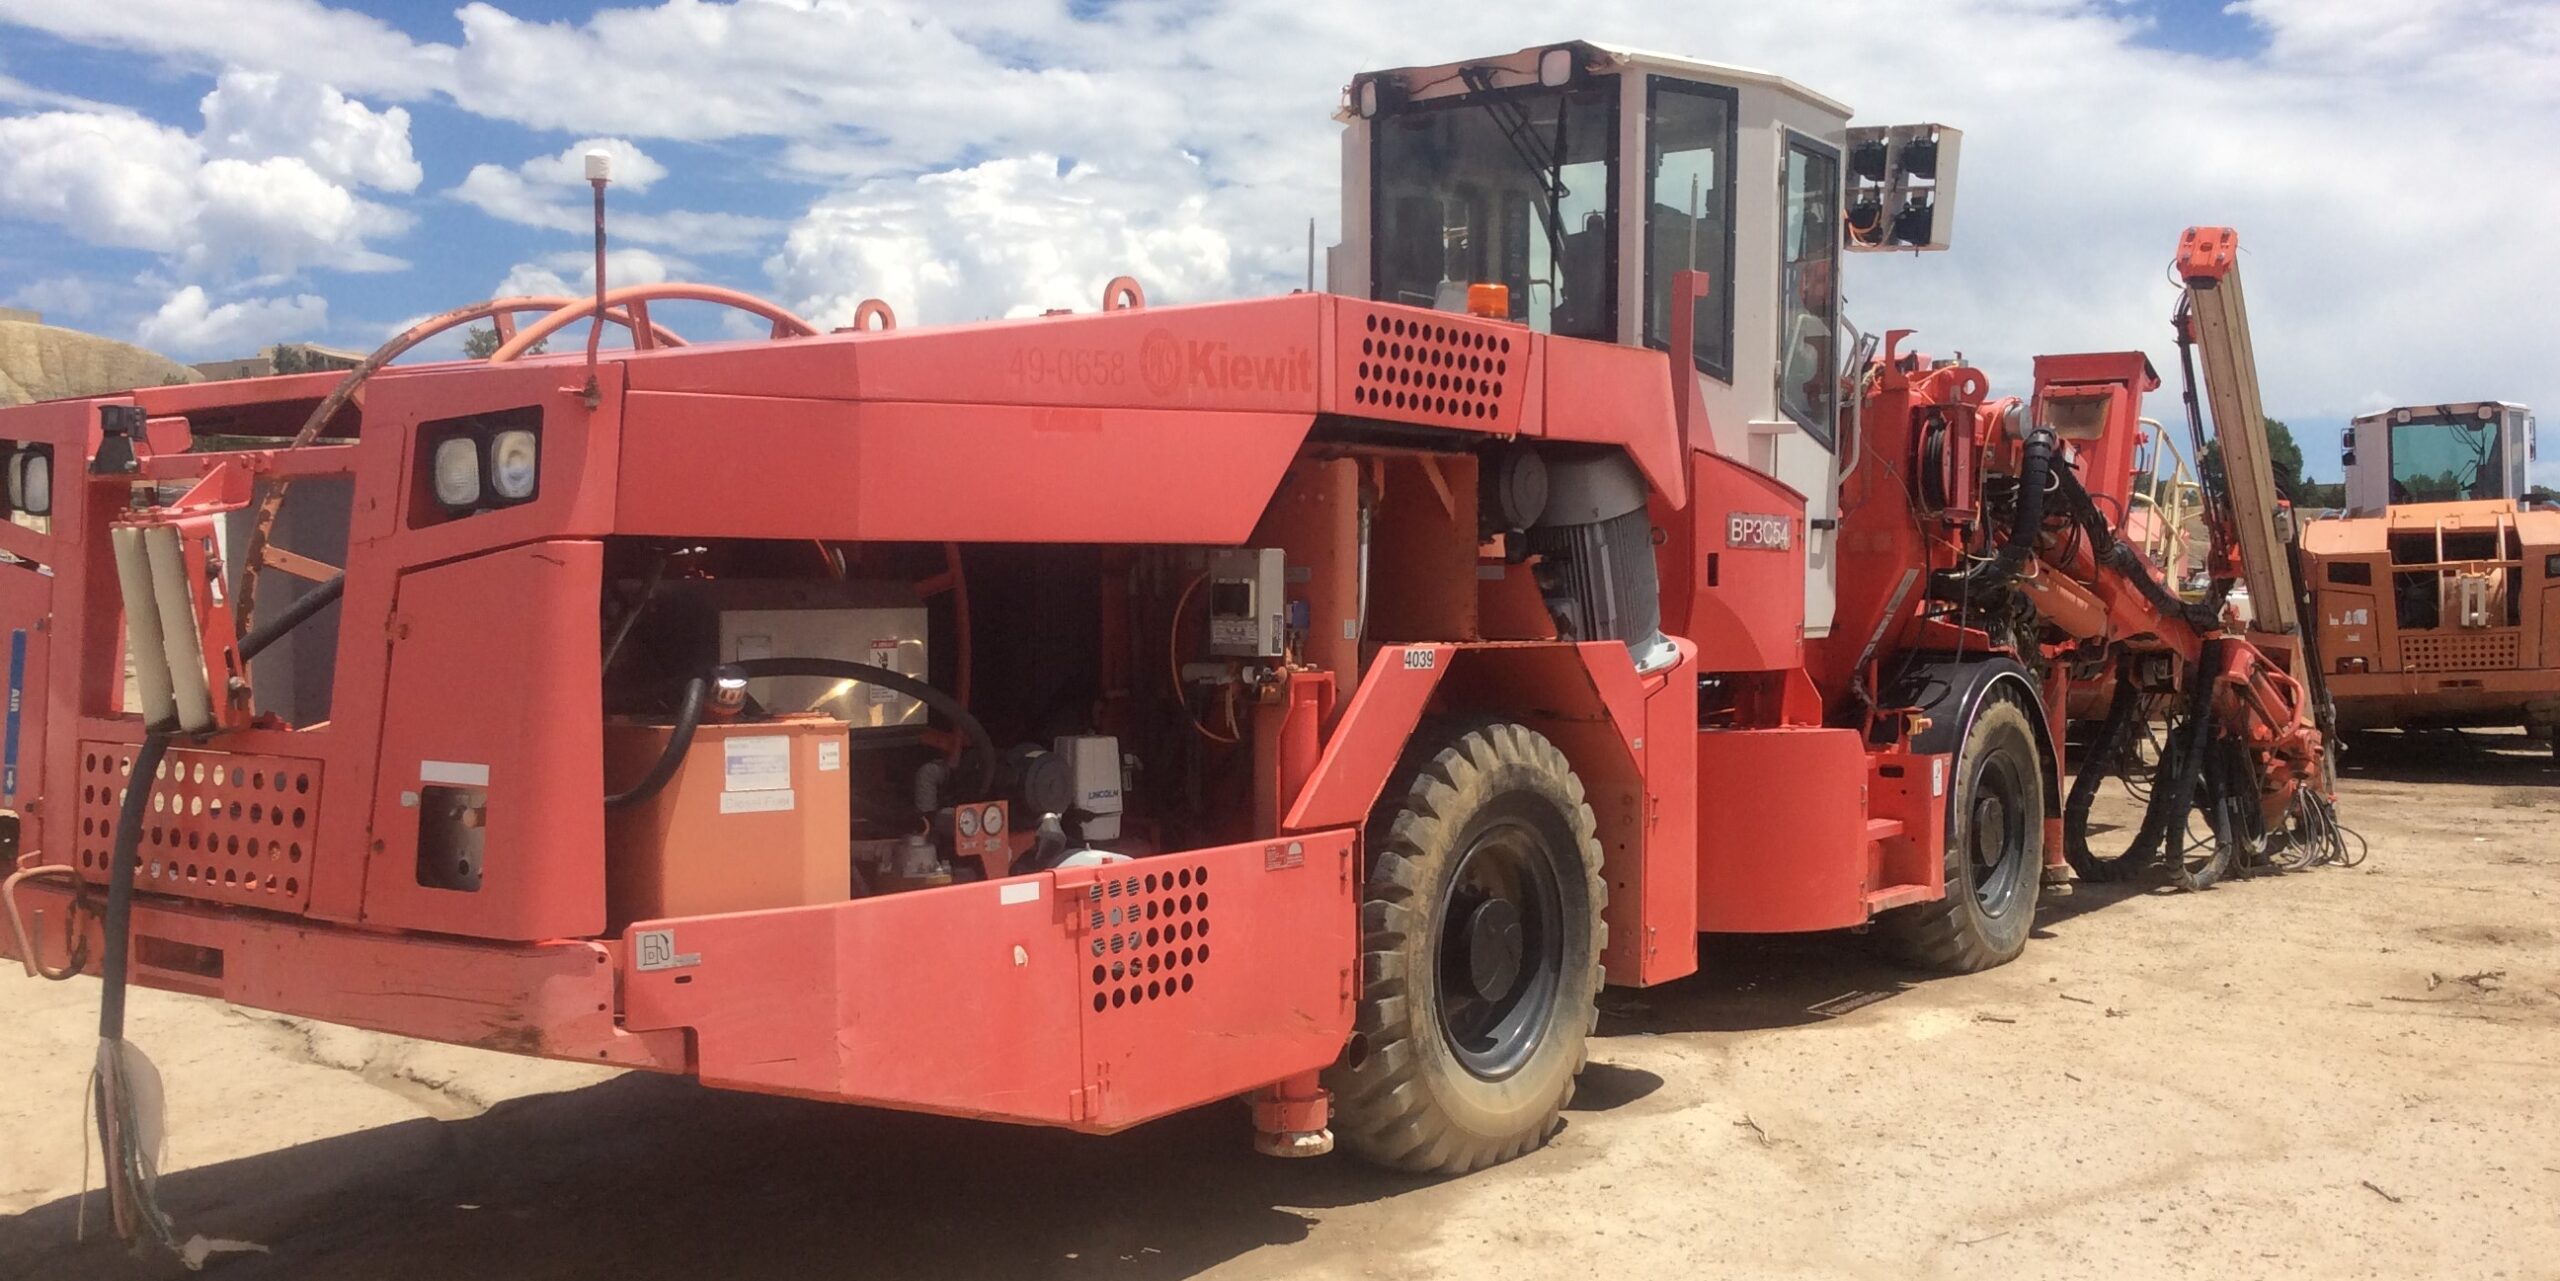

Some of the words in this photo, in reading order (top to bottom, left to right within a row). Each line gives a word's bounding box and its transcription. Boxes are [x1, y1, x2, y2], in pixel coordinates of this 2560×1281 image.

[1009, 347, 1126, 386] 49-0658
[1188, 340, 1313, 393] Kiewit
[1731, 518, 1789, 544] BP3C54
[1404, 651, 1434, 668] 4039
[10, 688, 21, 712] AIR
[1087, 789, 1119, 800] LINCOLN
